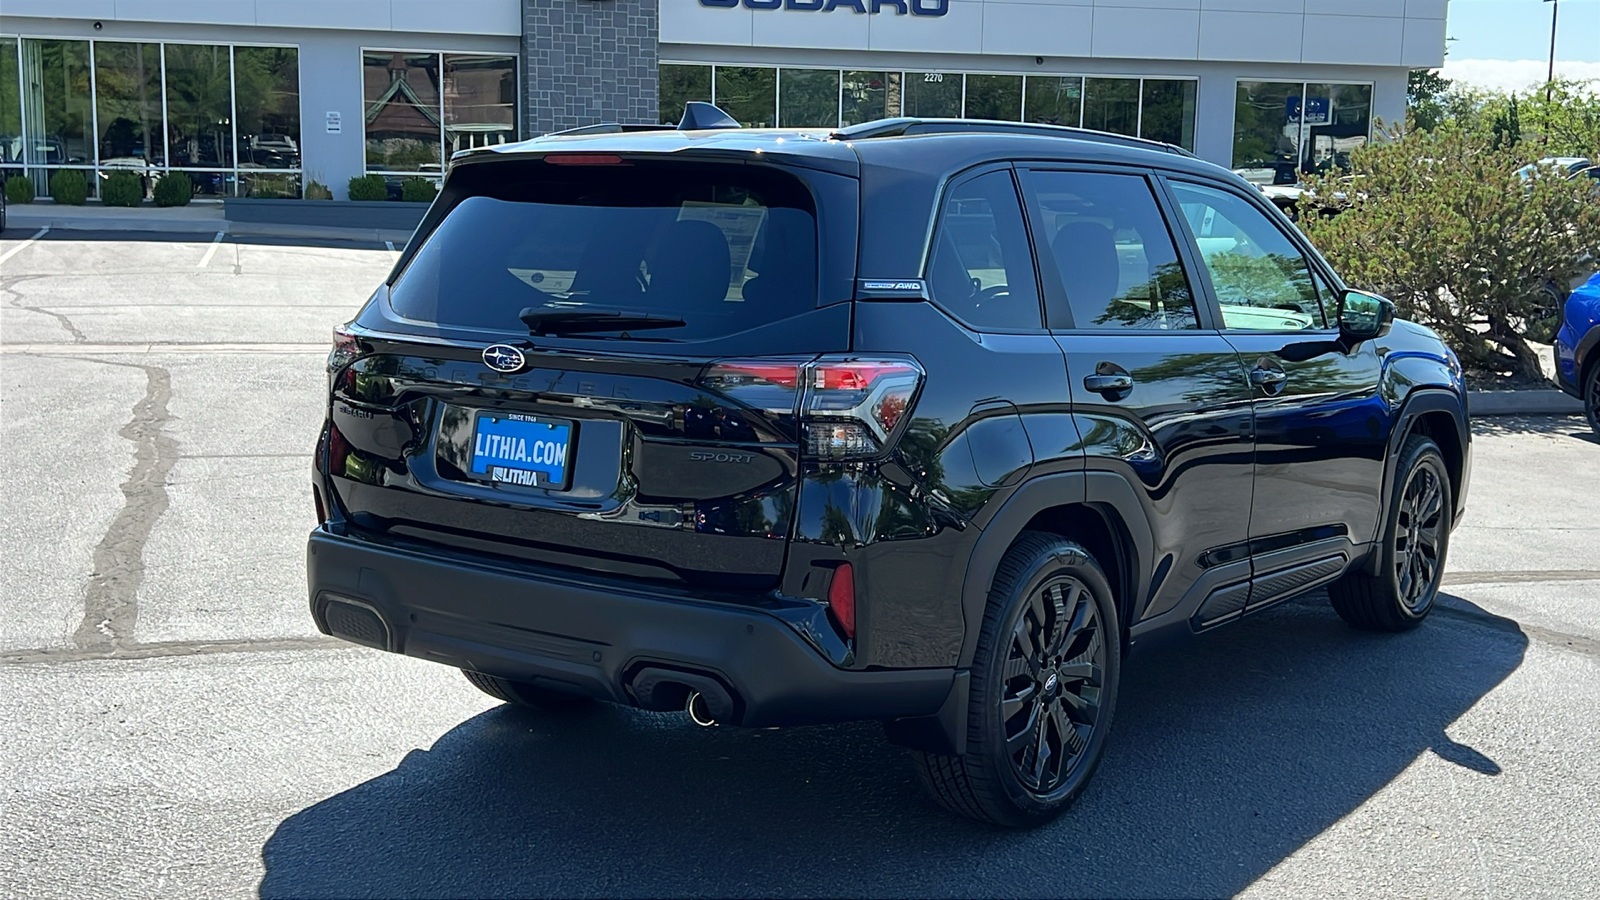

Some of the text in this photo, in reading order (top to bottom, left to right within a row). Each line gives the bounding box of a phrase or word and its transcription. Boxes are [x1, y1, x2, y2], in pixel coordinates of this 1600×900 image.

[924, 73, 943, 83] 2270
[508, 413, 524, 421] SINCE
[475, 433, 567, 467] LITHIA.COM
[690, 451, 757, 463] SPORT
[502, 468, 538, 486] LITHIA
